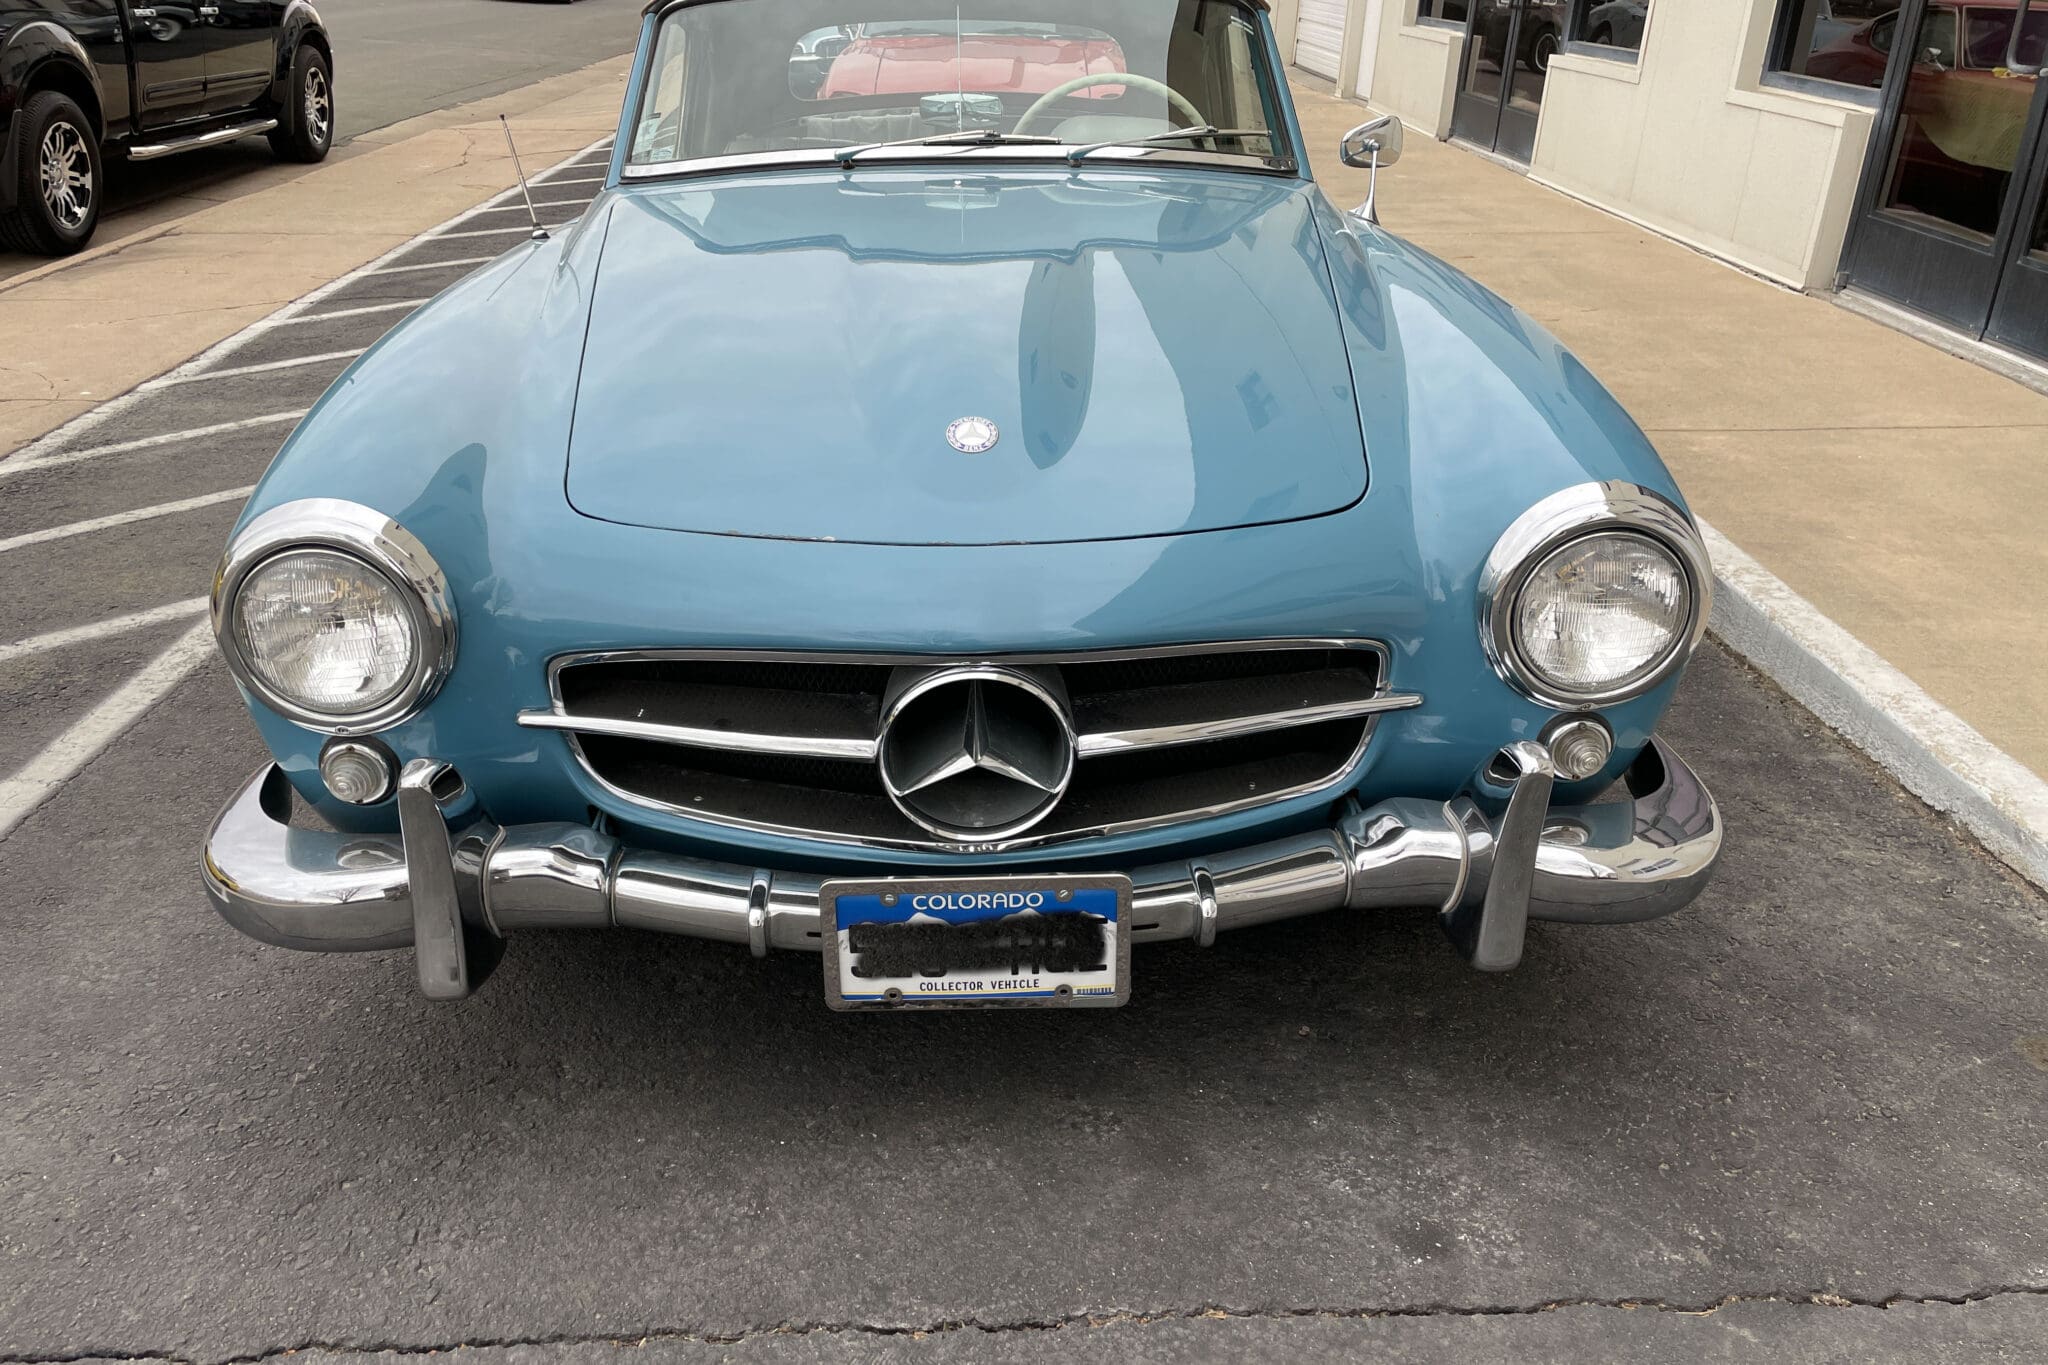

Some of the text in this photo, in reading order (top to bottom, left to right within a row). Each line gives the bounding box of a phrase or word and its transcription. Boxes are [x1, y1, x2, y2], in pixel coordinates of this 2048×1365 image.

[912, 892, 1044, 911] COLORADO
[919, 978, 1040, 991] COLLECTOR VEHICLE
